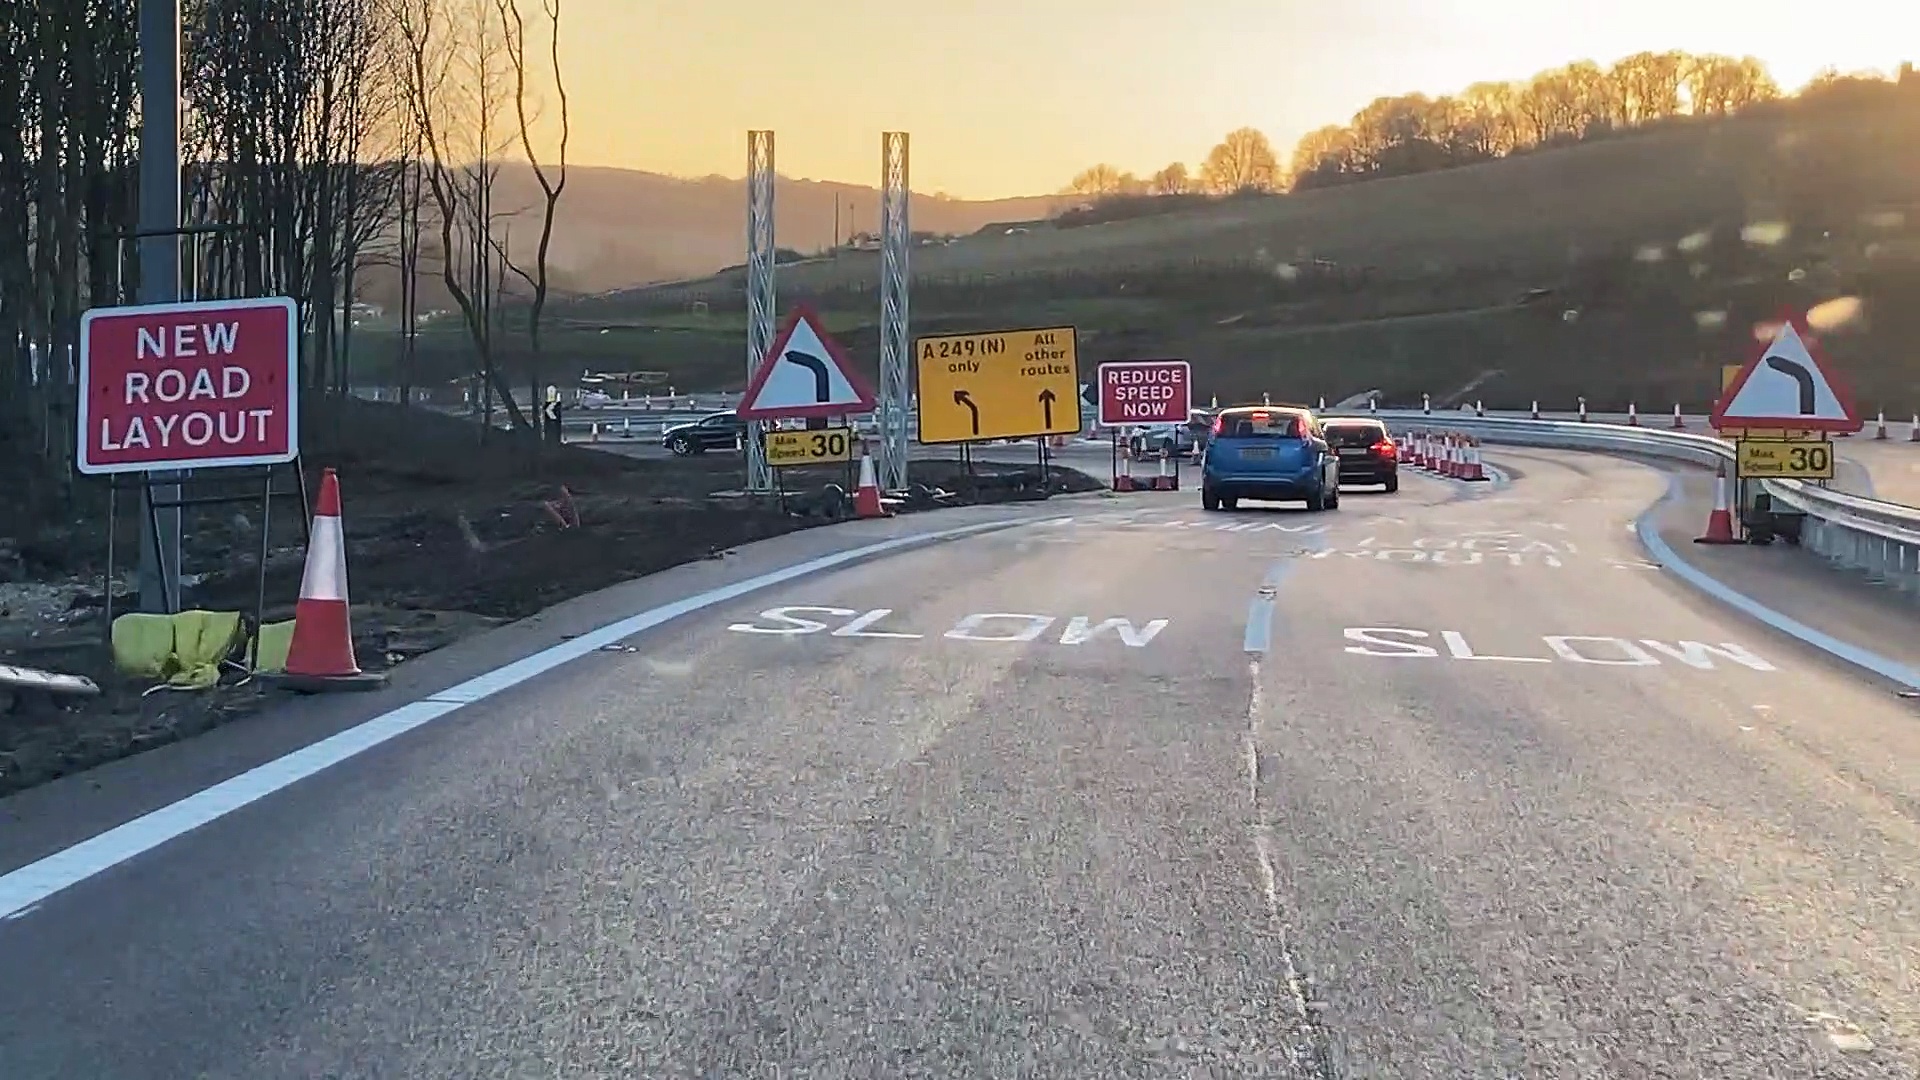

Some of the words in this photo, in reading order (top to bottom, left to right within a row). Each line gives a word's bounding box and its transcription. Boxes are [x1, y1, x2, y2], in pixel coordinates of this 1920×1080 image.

[137, 321, 239, 360] NEW
[1034, 333, 1056, 346] All
[1024, 348, 1066, 361] other
[948, 360, 981, 374] only
[1020, 363, 1070, 377] routes
[1108, 369, 1182, 384] REDUCE
[125, 367, 251, 405] ROAD
[1115, 386, 1174, 400] SPEED
[1123, 402, 1167, 417] NOW
[101, 409, 273, 451] LAYOUT
[811, 434, 845, 457] 30
[1789, 447, 1828, 472] 30
[727, 606, 1169, 647] SLOW
[1343, 627, 1777, 671] SLOW
